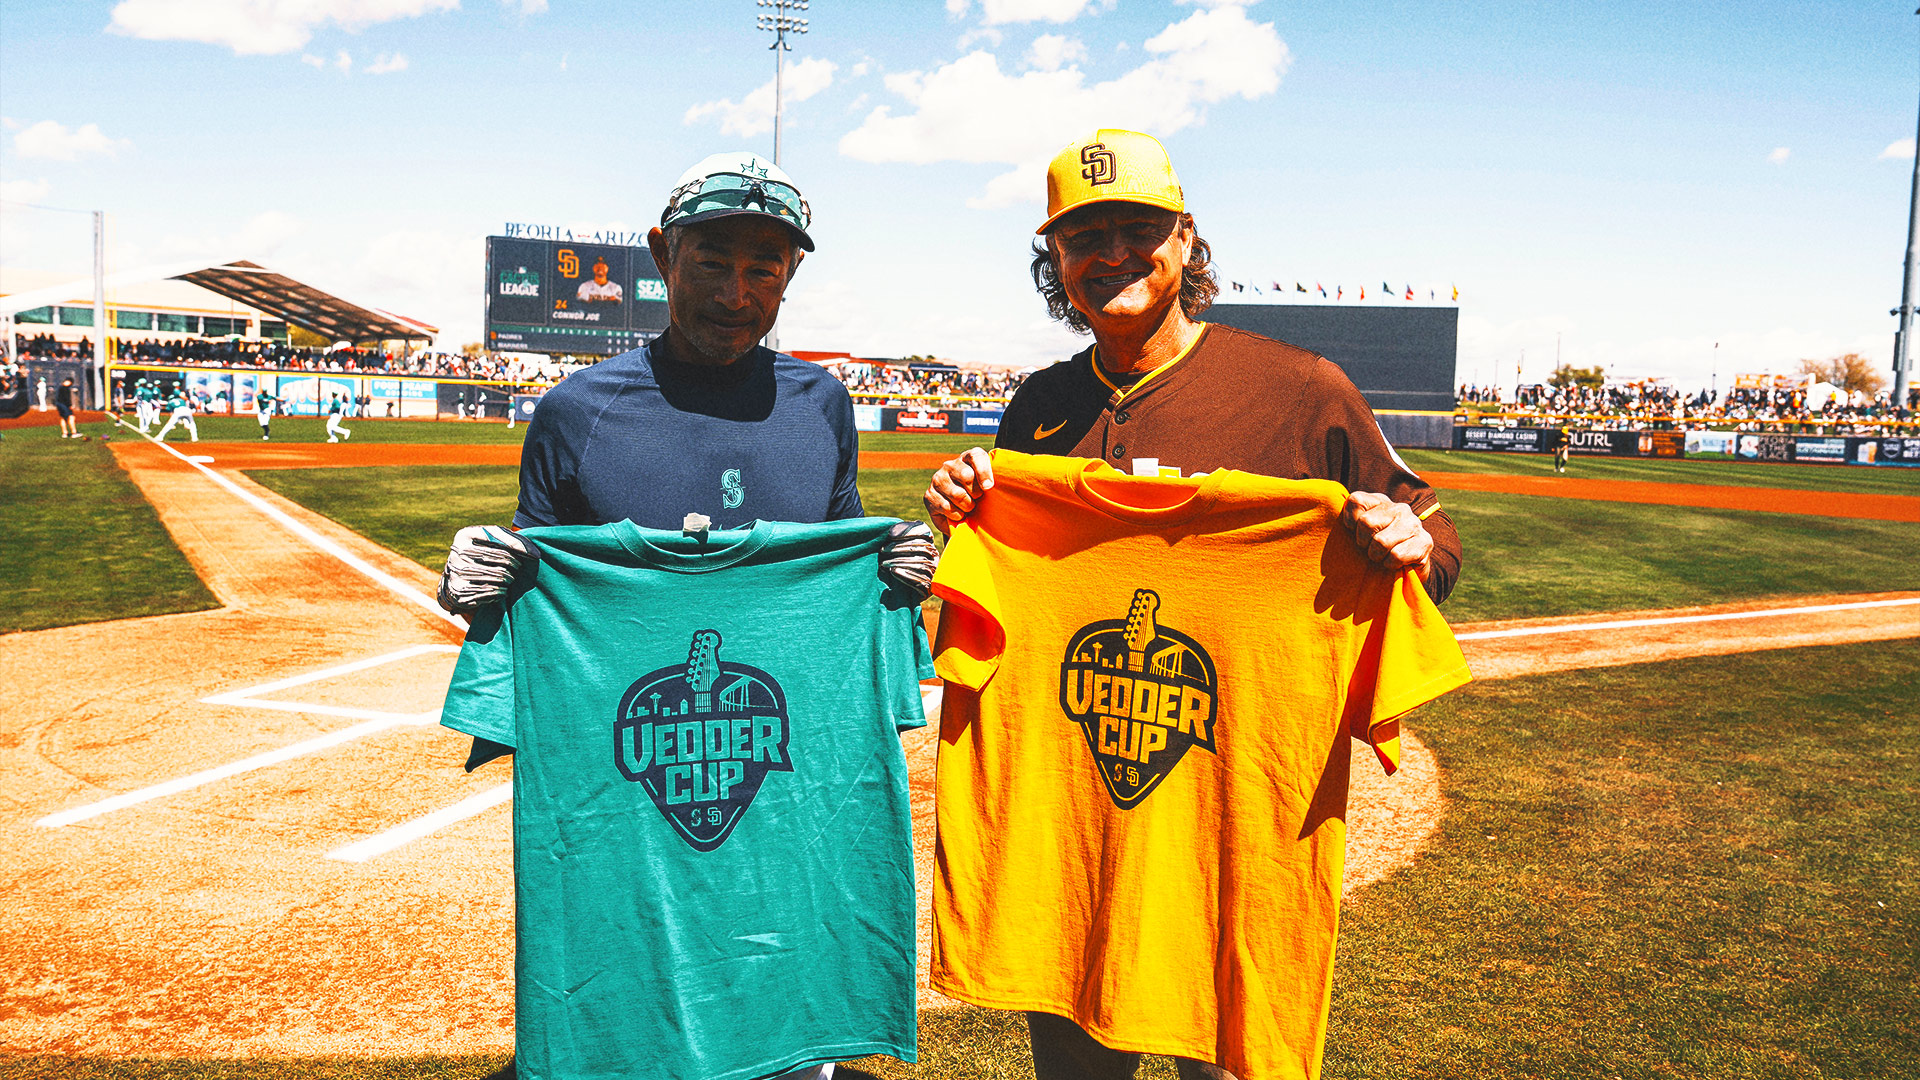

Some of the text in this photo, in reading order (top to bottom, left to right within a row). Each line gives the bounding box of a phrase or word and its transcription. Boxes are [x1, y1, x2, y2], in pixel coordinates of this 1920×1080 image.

[1081, 143, 1116, 187] SD
[505, 222, 649, 247] PEORIA ARIZO
[557, 249, 579, 278] SD
[500, 271, 540, 284] CACTUS
[500, 282, 539, 297] LEAGUE
[637, 279, 667, 294] SEA
[552, 311, 600, 322] CONNOR JOE
[555, 299, 568, 310] 24
[1465, 431, 1538, 441] DESERT DIAMOND CASINO
[720, 468, 746, 509] S
[1066, 669, 1211, 742] VEDDER
[622, 715, 783, 774] VEDDER
[1098, 715, 1168, 764] CUP
[665, 761, 744, 805] CUP
